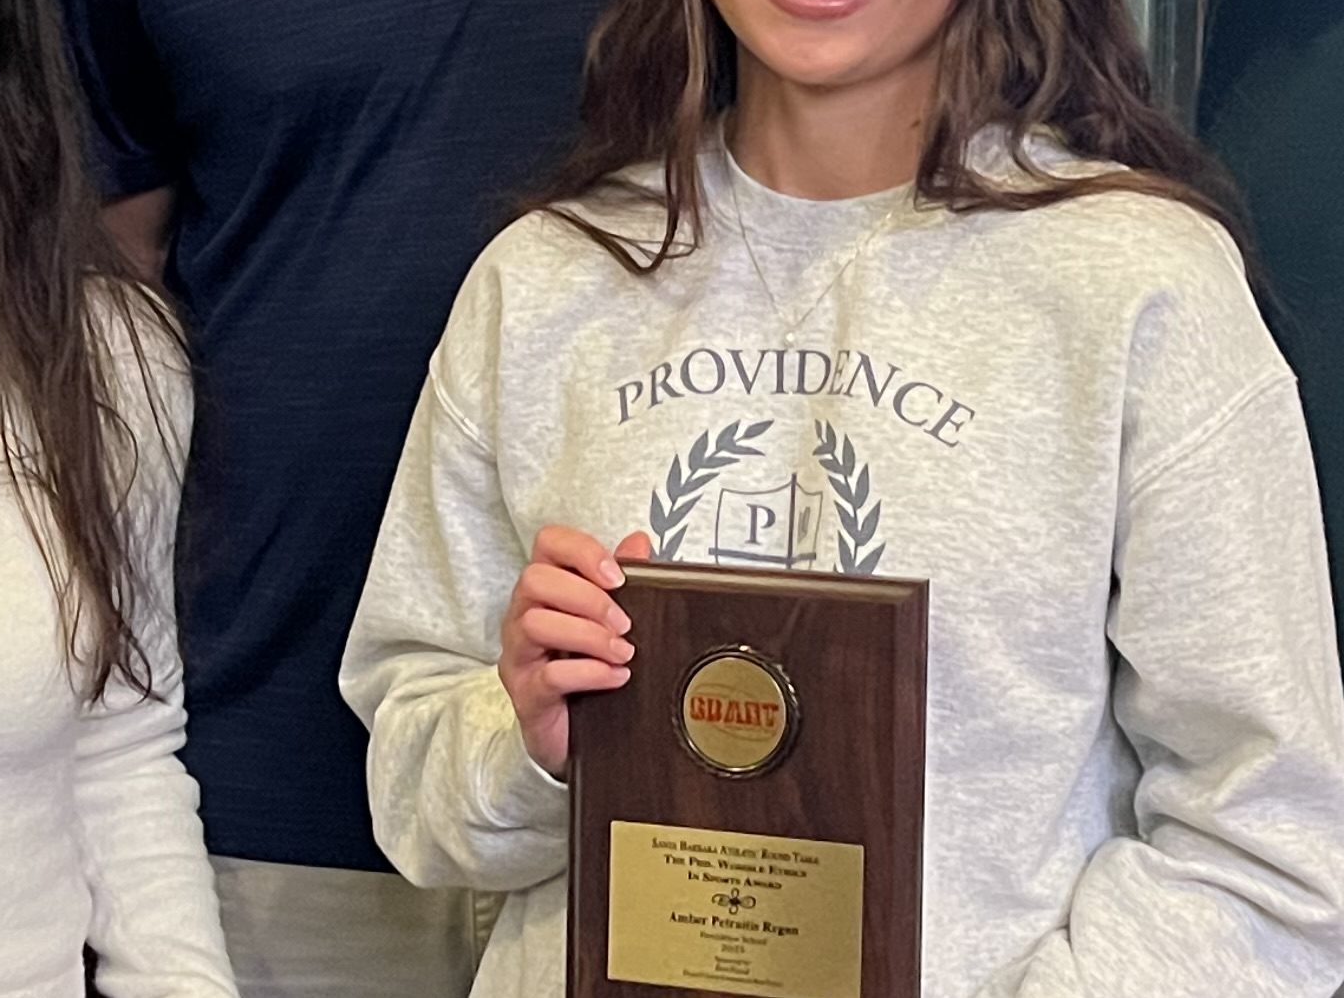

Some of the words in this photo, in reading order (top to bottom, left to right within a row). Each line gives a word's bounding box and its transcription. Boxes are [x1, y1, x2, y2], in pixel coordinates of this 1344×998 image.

[614, 347, 976, 448] PROVIDENCE
[744, 503, 776, 546] P
[669, 911, 708, 926] Amber
